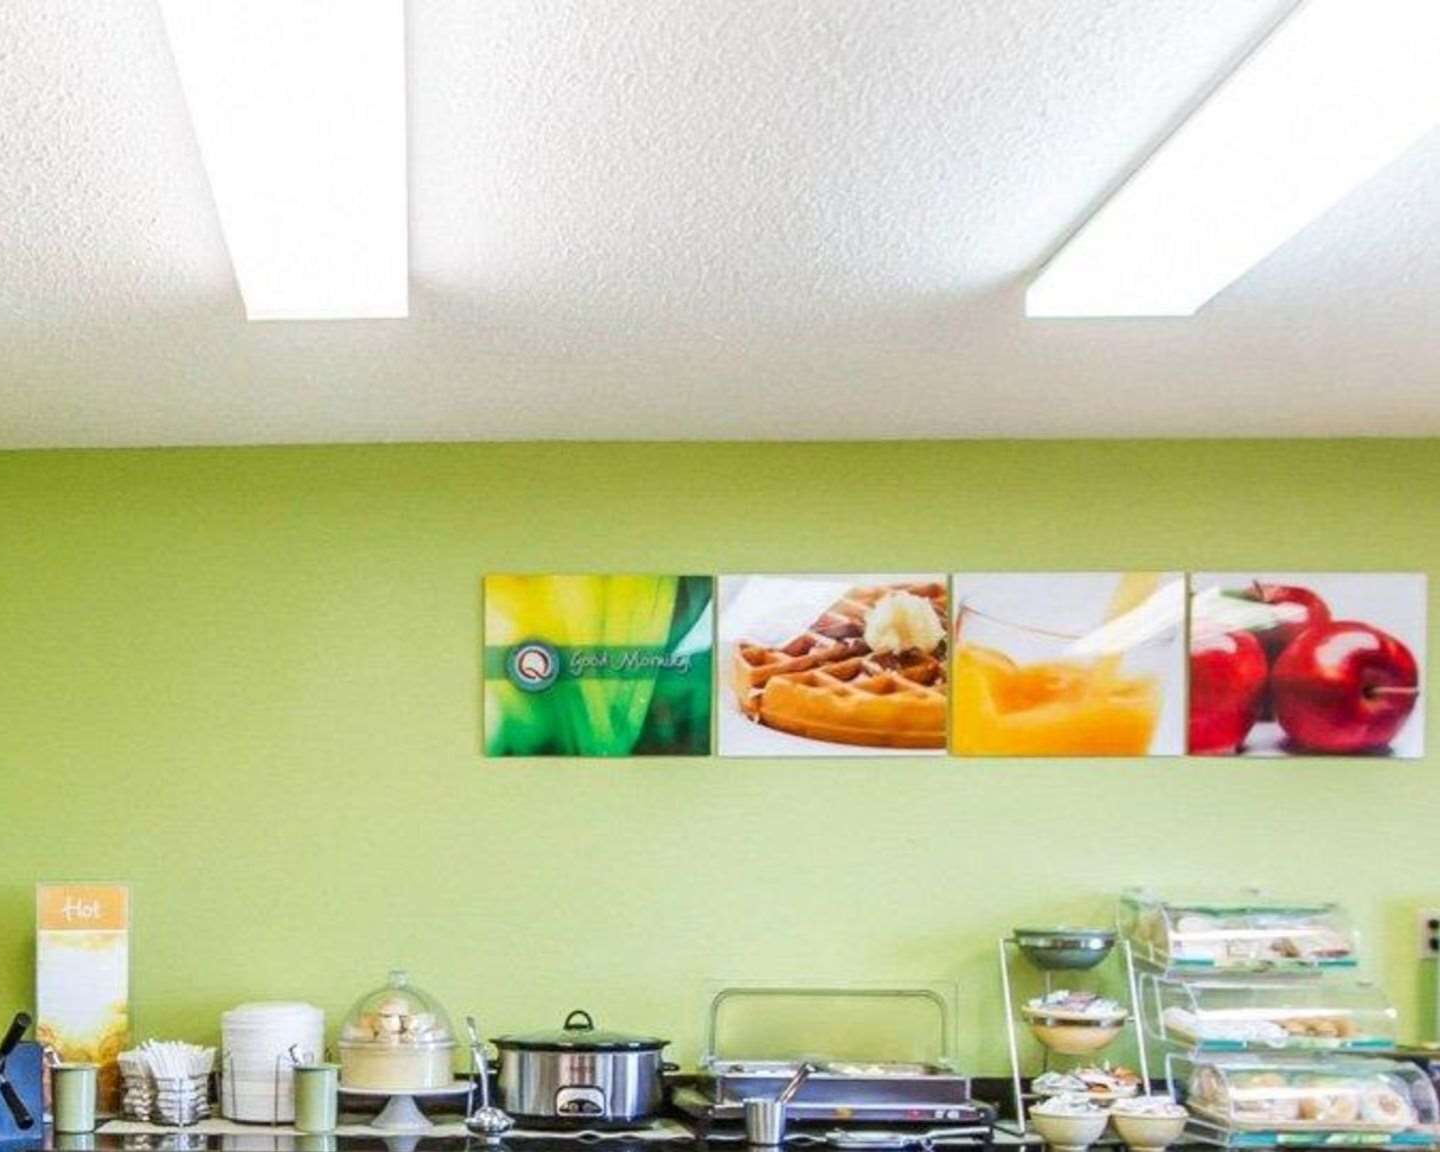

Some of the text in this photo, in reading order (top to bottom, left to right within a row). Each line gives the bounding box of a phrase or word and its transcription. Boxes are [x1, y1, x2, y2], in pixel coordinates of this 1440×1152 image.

[569, 650, 608, 677] Good
[609, 649, 691, 676] Morning
[63, 898, 100, 920] Hot
